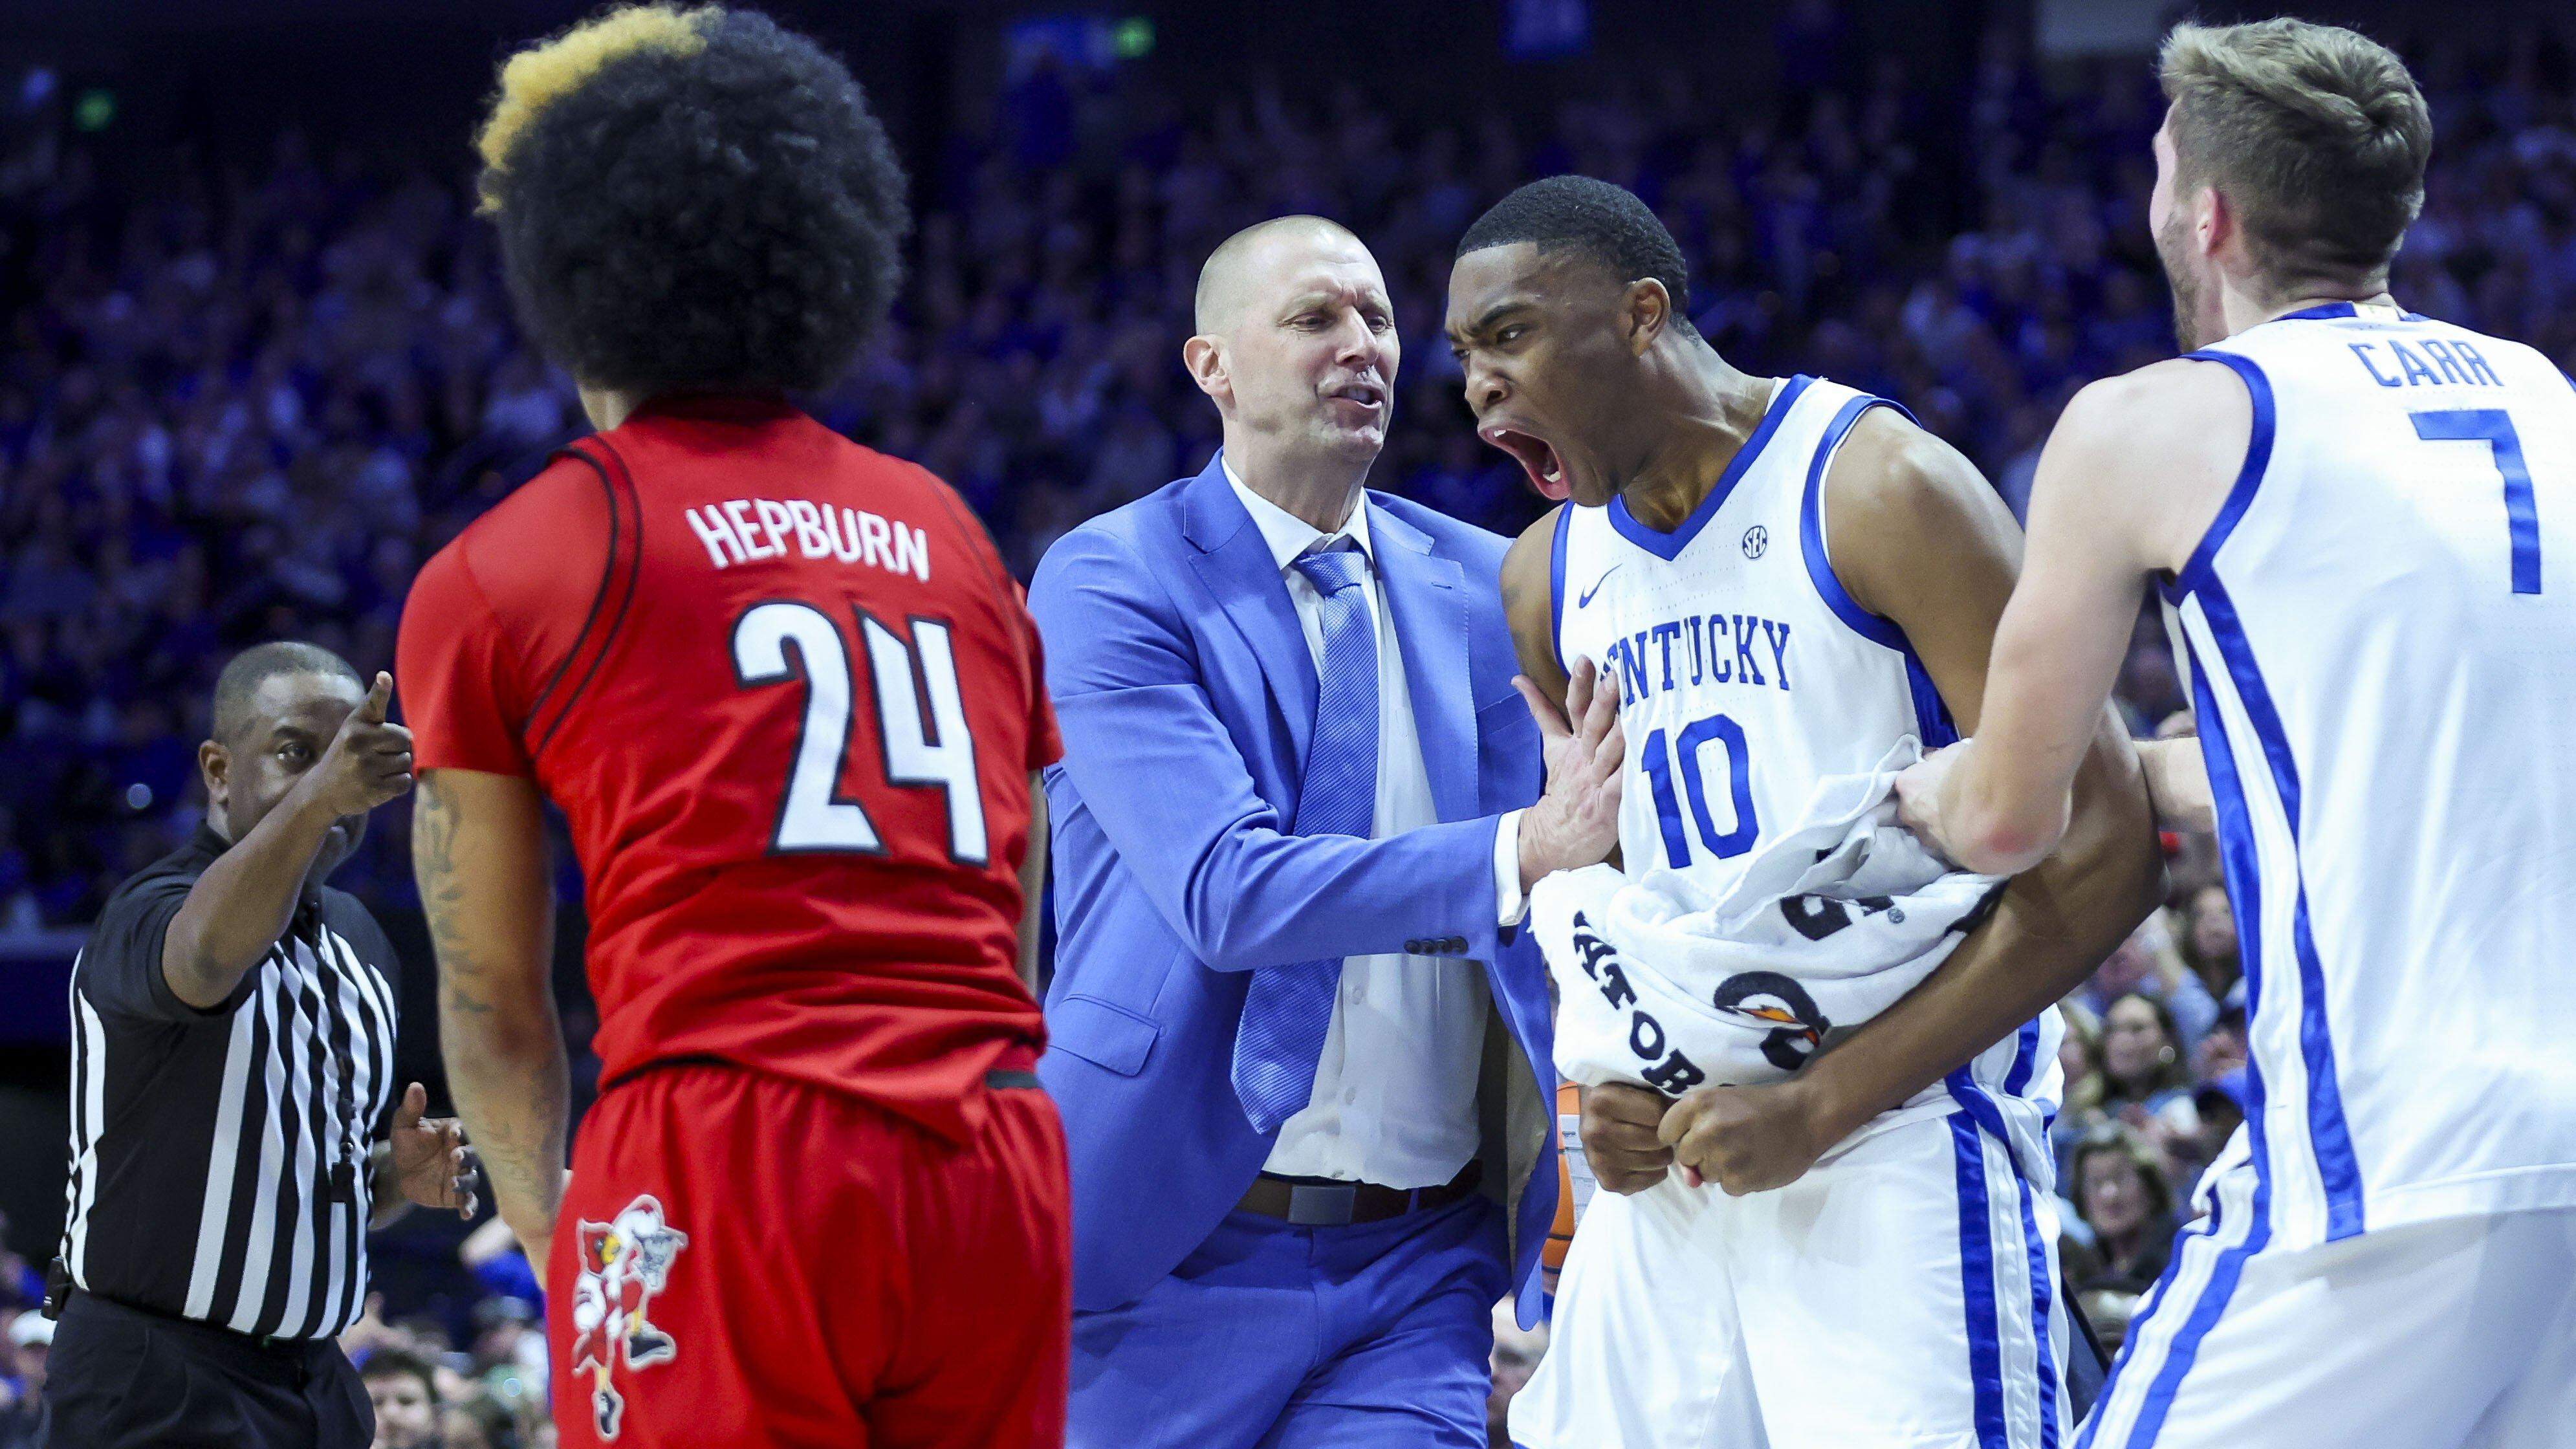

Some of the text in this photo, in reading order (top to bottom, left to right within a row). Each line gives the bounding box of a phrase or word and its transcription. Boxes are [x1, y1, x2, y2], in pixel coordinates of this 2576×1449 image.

[2348, 340, 2505, 386] CARR
[686, 498, 930, 582] HEPBURN
[1743, 526, 1767, 558] SEC
[2408, 409, 2542, 594] 7
[1600, 615, 1791, 706] NTUCKY
[727, 598, 988, 869] 24
[1641, 714, 1759, 869] 10
[1573, 910, 1706, 1095] ATOR
